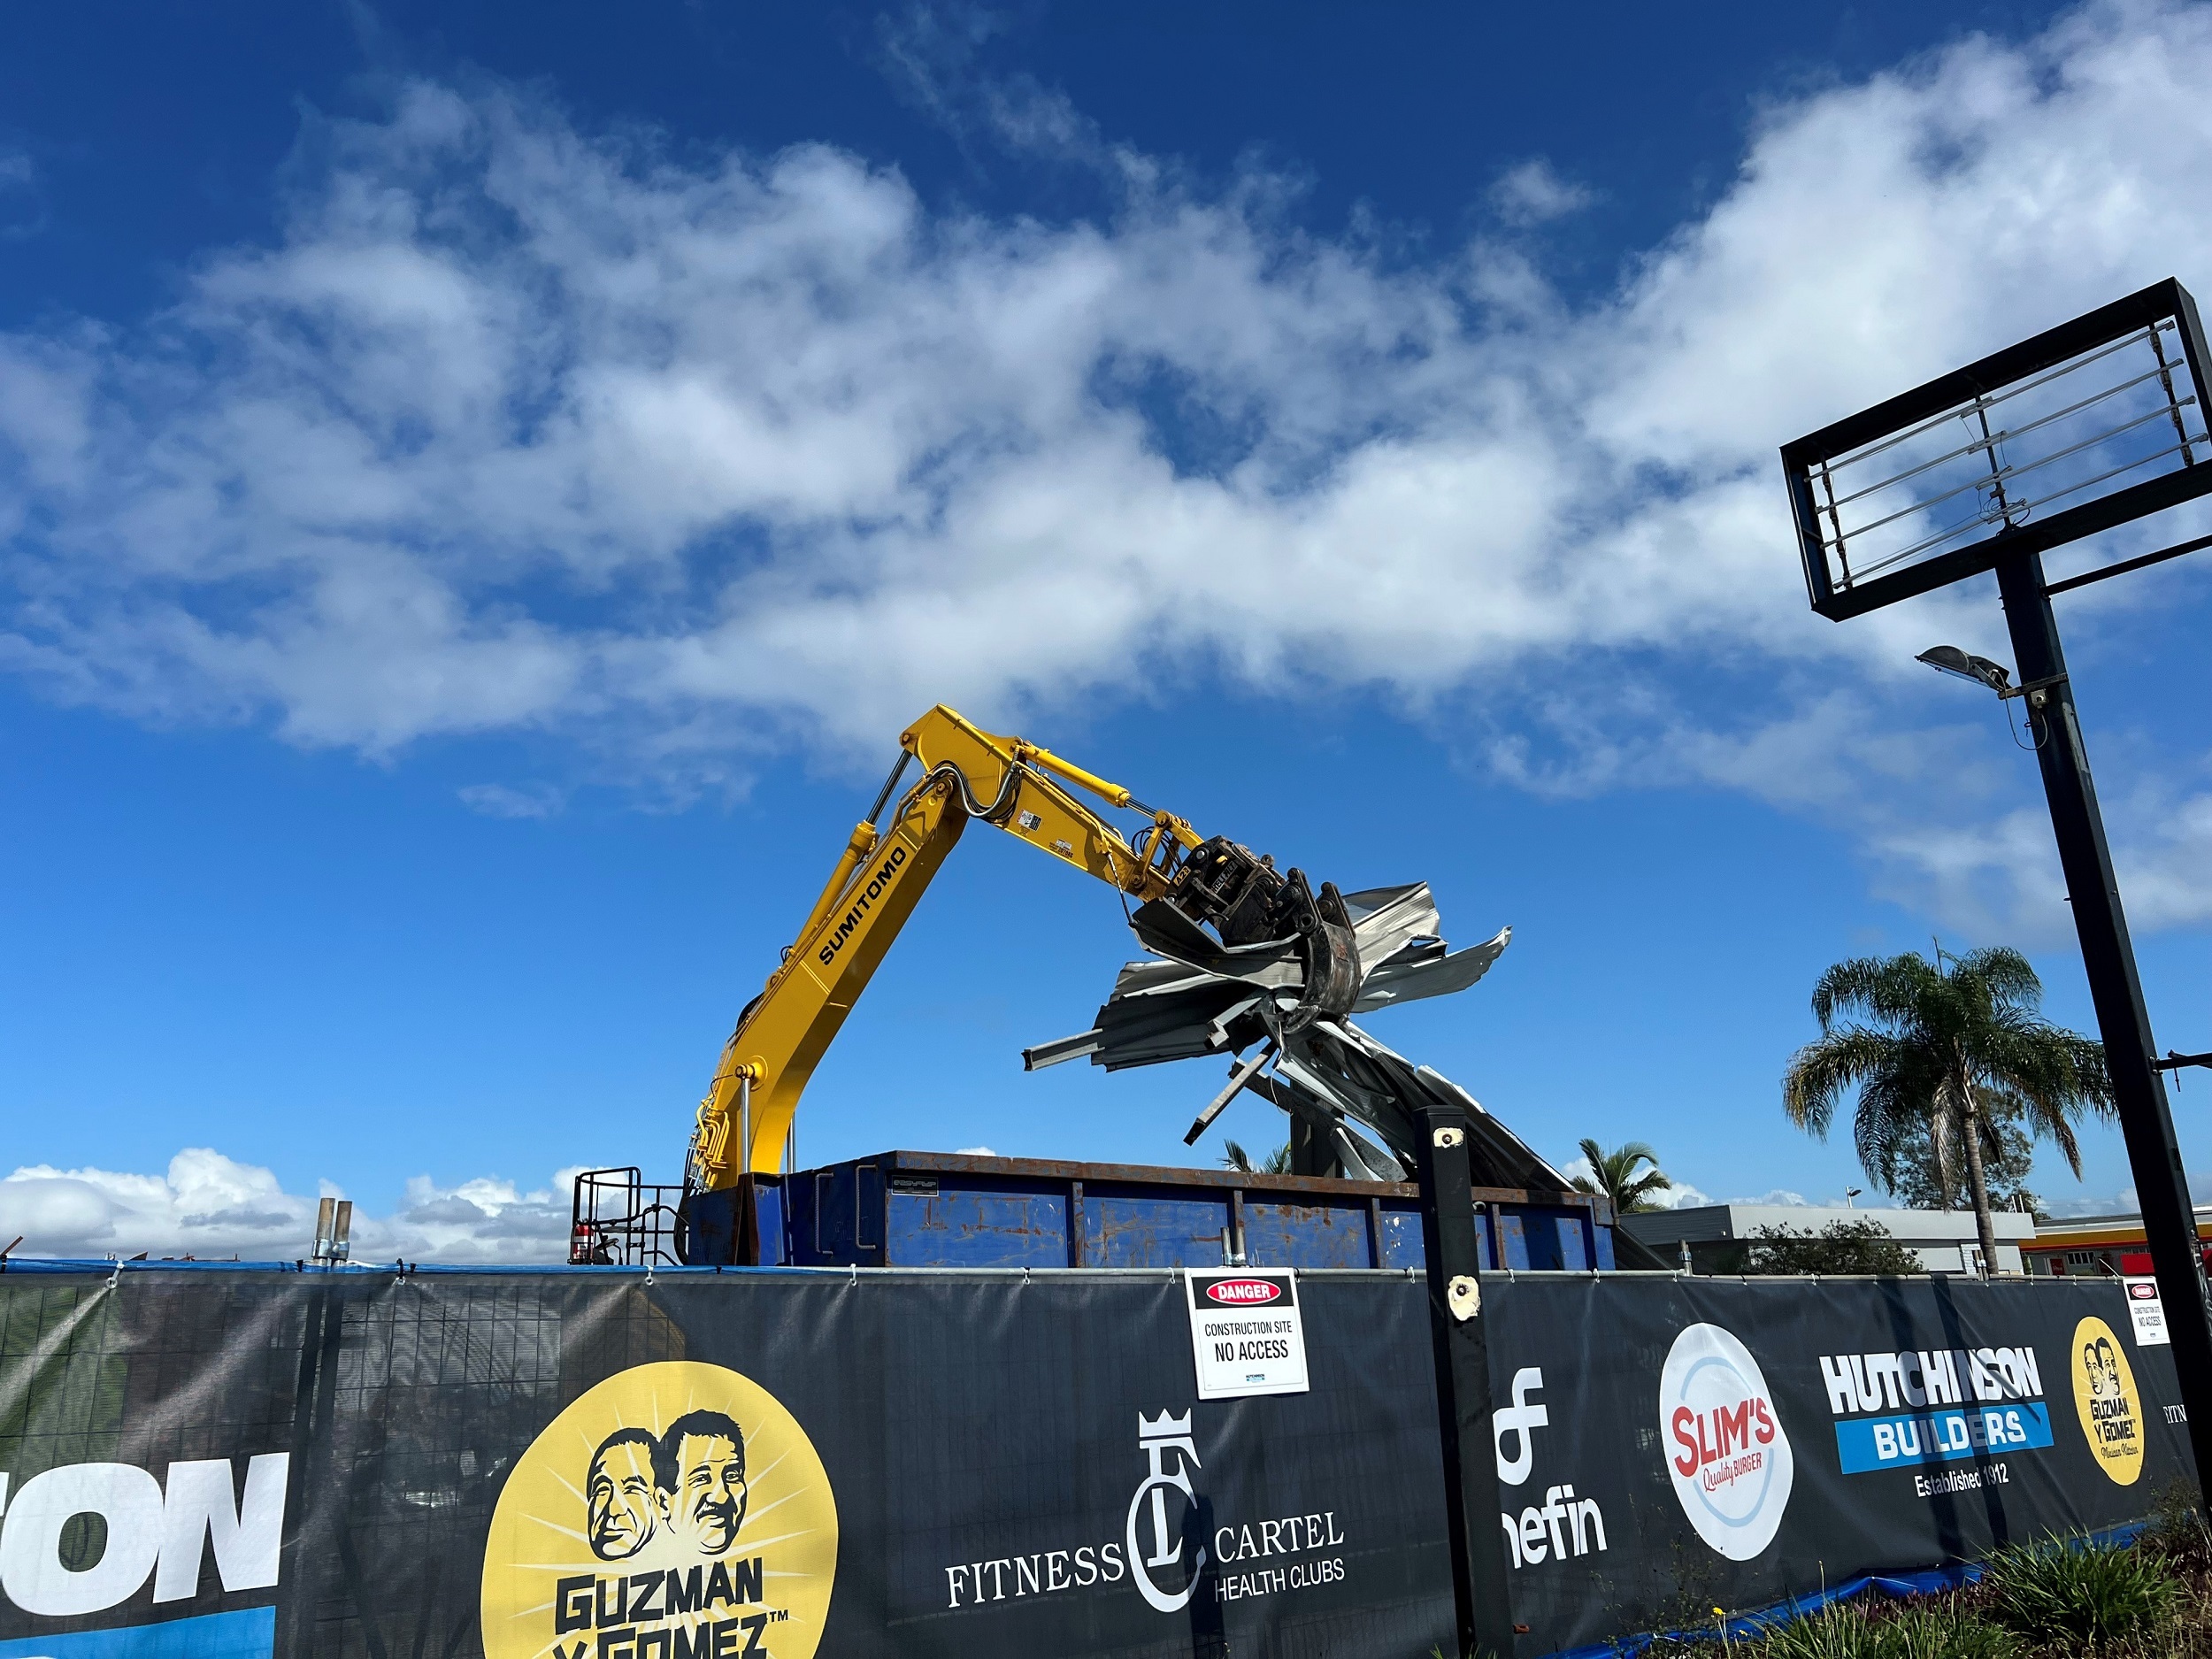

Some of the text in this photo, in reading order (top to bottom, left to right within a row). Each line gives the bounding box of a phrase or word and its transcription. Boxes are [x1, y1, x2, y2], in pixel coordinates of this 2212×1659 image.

[818, 846, 907, 966] SUMITOMO
[1217, 1285, 1271, 1300] DANGER
[1204, 1320, 1293, 1337] CONSTRUCTION SITE
[2138, 1316, 2162, 1327] NO ACCESS
[1215, 1340, 1288, 1363] NO ACCESS
[1819, 1347, 2043, 1414] HUTCHINSON
[2090, 1397, 2130, 1421] GUZMAN
[1672, 1397, 1775, 1478] SLIM'S
[1873, 1410, 2026, 1460] BUILDERS
[2094, 1420, 2136, 1443] Y GOMEZ
[1703, 1452, 1762, 1492] Quality BURGER
[1914, 1463, 2009, 1497] Established 1912
[0, 1452, 290, 1616] ON
[946, 1512, 1345, 1608] FITNESS CARTEL
[1215, 1558, 1345, 1602] HEALTH CLUBS
[556, 1557, 762, 1635] GUZMAN
